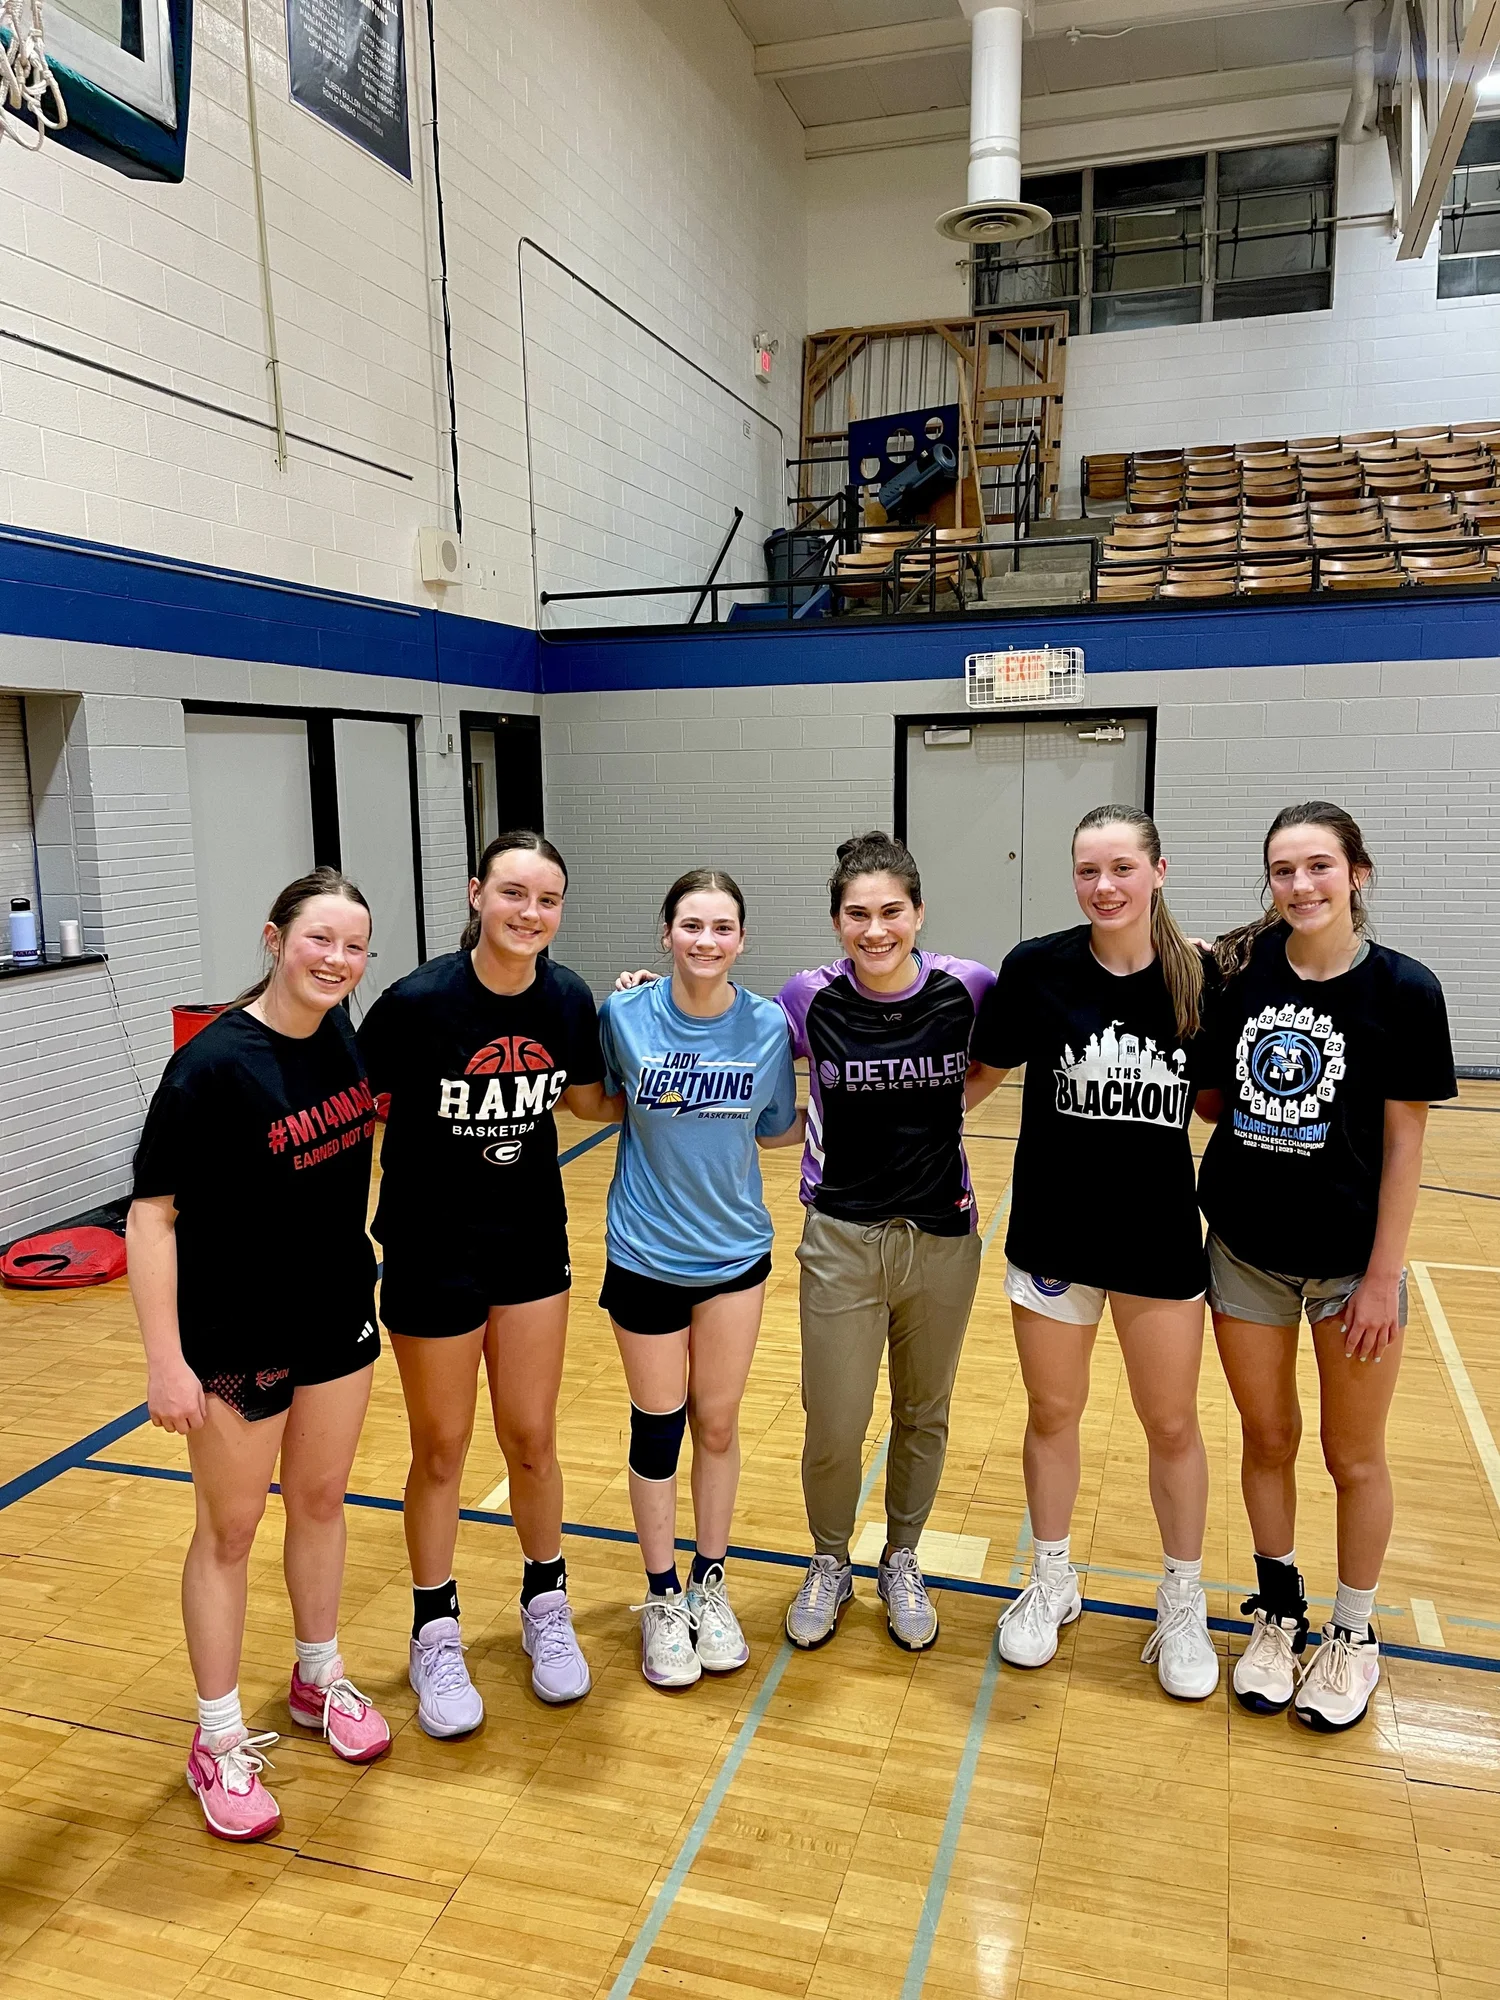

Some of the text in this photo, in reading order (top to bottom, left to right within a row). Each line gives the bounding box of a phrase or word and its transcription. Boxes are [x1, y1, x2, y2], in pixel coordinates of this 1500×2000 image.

[1005, 655, 1041, 682] EXIT
[1260, 1015, 1274, 1025] 33
[1279, 1013, 1293, 1023] 32
[1298, 1015, 1310, 1025] 31
[1245, 1027, 1255, 1037] 40
[1315, 1024, 1330, 1034] 25
[1327, 1042, 1342, 1052] 23
[663, 1052, 700, 1069] LADY
[845, 1051, 966, 1083] DETAILED
[1239, 1067, 1246, 1077] 2
[1329, 1064, 1342, 1074] 21
[1107, 1067, 1142, 1080] LTHS
[636, 1067, 754, 1104] LIGHTNING
[437, 1069, 567, 1120] RAMS
[1243, 1086, 1250, 1096] 3
[1318, 1086, 1331, 1097] 15
[1055, 1071, 1188, 1126] BLACKOUT
[1254, 1100, 1261, 1110] 5
[1304, 1103, 1316, 1113] 13
[698, 1112, 749, 1120] BASKETBALL
[1270, 1107, 1277, 1116] 11
[1285, 1109, 1296, 1119] 12
[452, 1119, 539, 1137] BASKETBA
[1233, 1108, 1331, 1141] NAZARETH ACADEMY
[1234, 1128, 1248, 1139] BACK
[1253, 1133, 1270, 1143] BACK
[1270, 1137, 1288, 1146] ESCC
[1288, 1139, 1325, 1150] CHAMPIONS
[293, 1139, 340, 1170] EARNED
[341, 1127, 361, 1150] NOT
